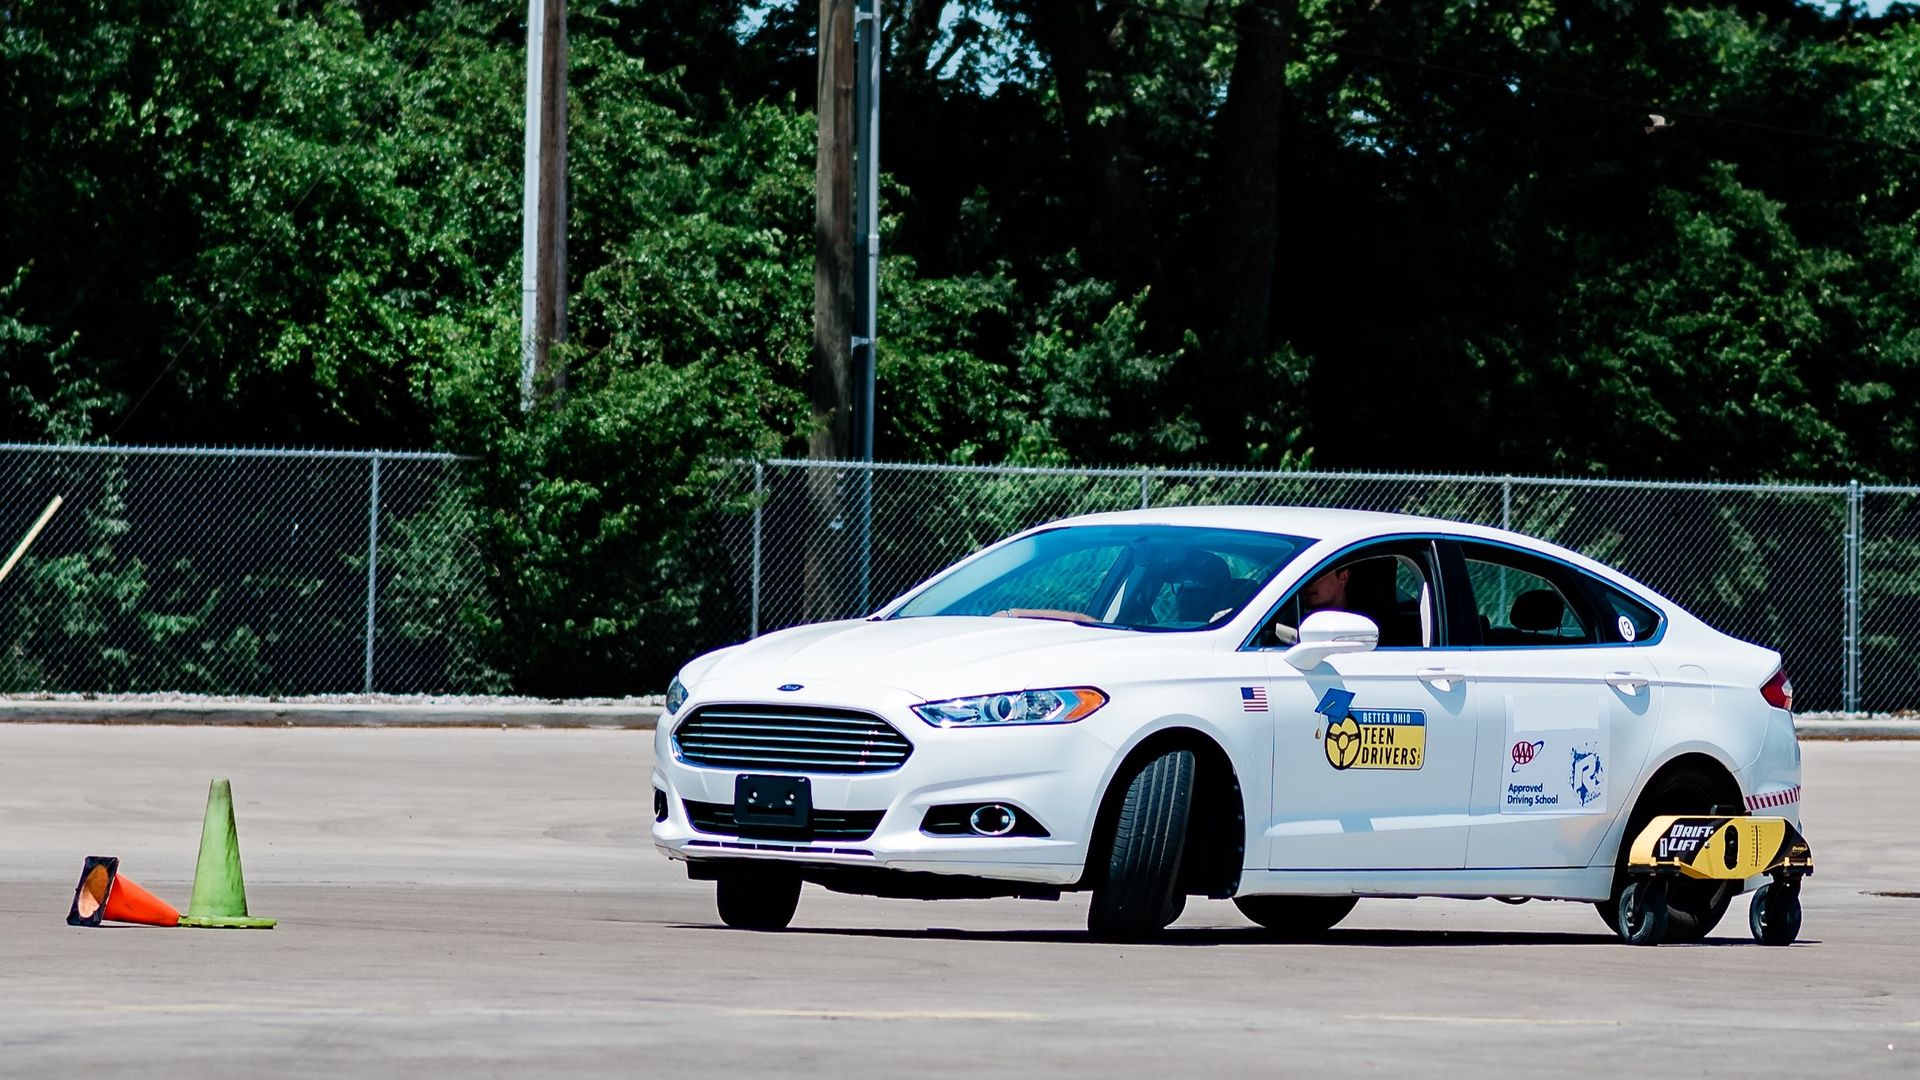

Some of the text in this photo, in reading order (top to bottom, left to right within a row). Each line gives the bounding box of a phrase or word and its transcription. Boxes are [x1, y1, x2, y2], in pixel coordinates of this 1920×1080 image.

[1620, 620, 1633, 637] 13
[1362, 712, 1411, 724] BETTER OHIO
[1363, 727, 1395, 745] TEEN
[1361, 746, 1417, 765] DRIVERS
[1507, 783, 1543, 794] Approved
[1507, 794, 1559, 806] Driving School
[1668, 838, 1699, 850] LIFT
